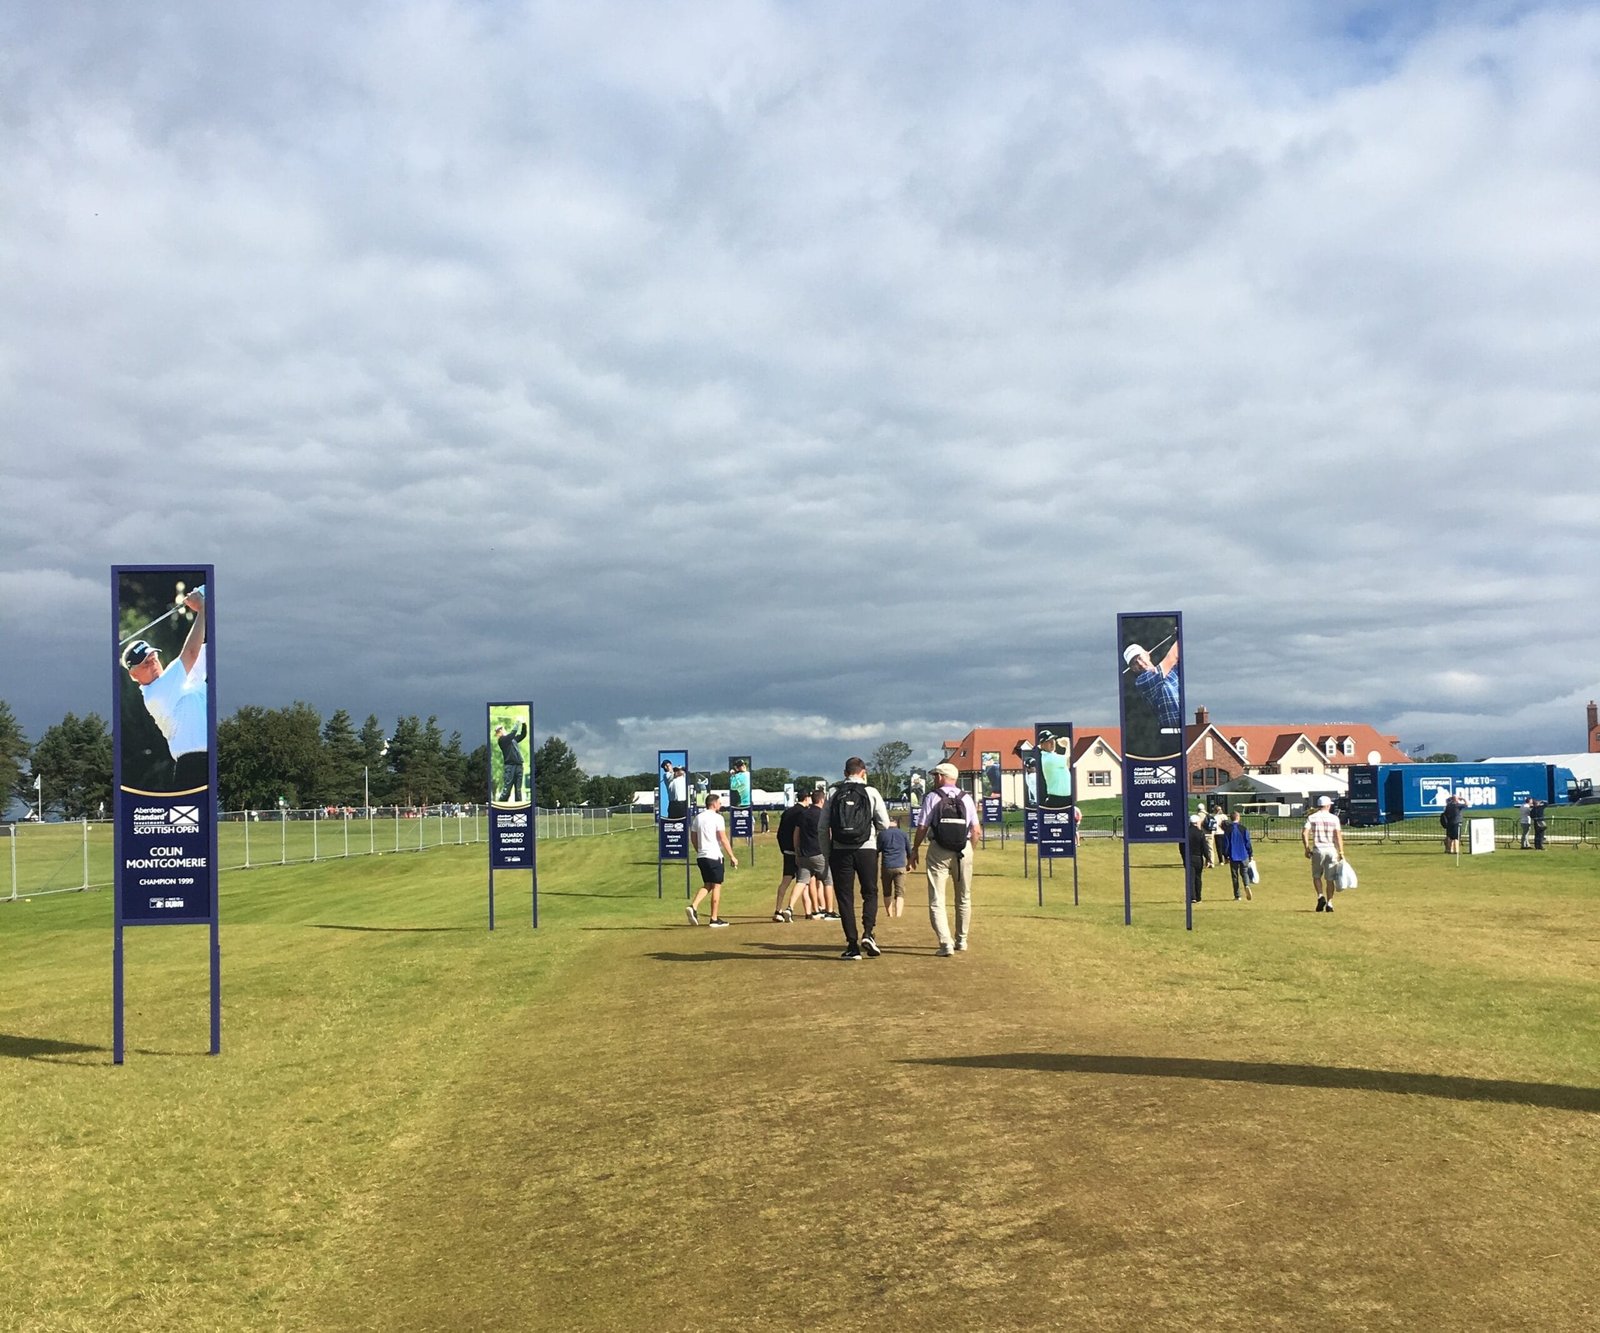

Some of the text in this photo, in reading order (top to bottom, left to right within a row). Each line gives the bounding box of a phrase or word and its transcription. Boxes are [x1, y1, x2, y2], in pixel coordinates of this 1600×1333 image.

[1464, 776, 1490, 784] RACE TO
[1455, 786, 1496, 807] DUBAI
[133, 825, 199, 834] SCOTTISH OPEN
[149, 847, 183, 856] COLIN
[126, 858, 207, 869] MONTGOMERIE
[139, 877, 194, 886] CHAMPION 1999
